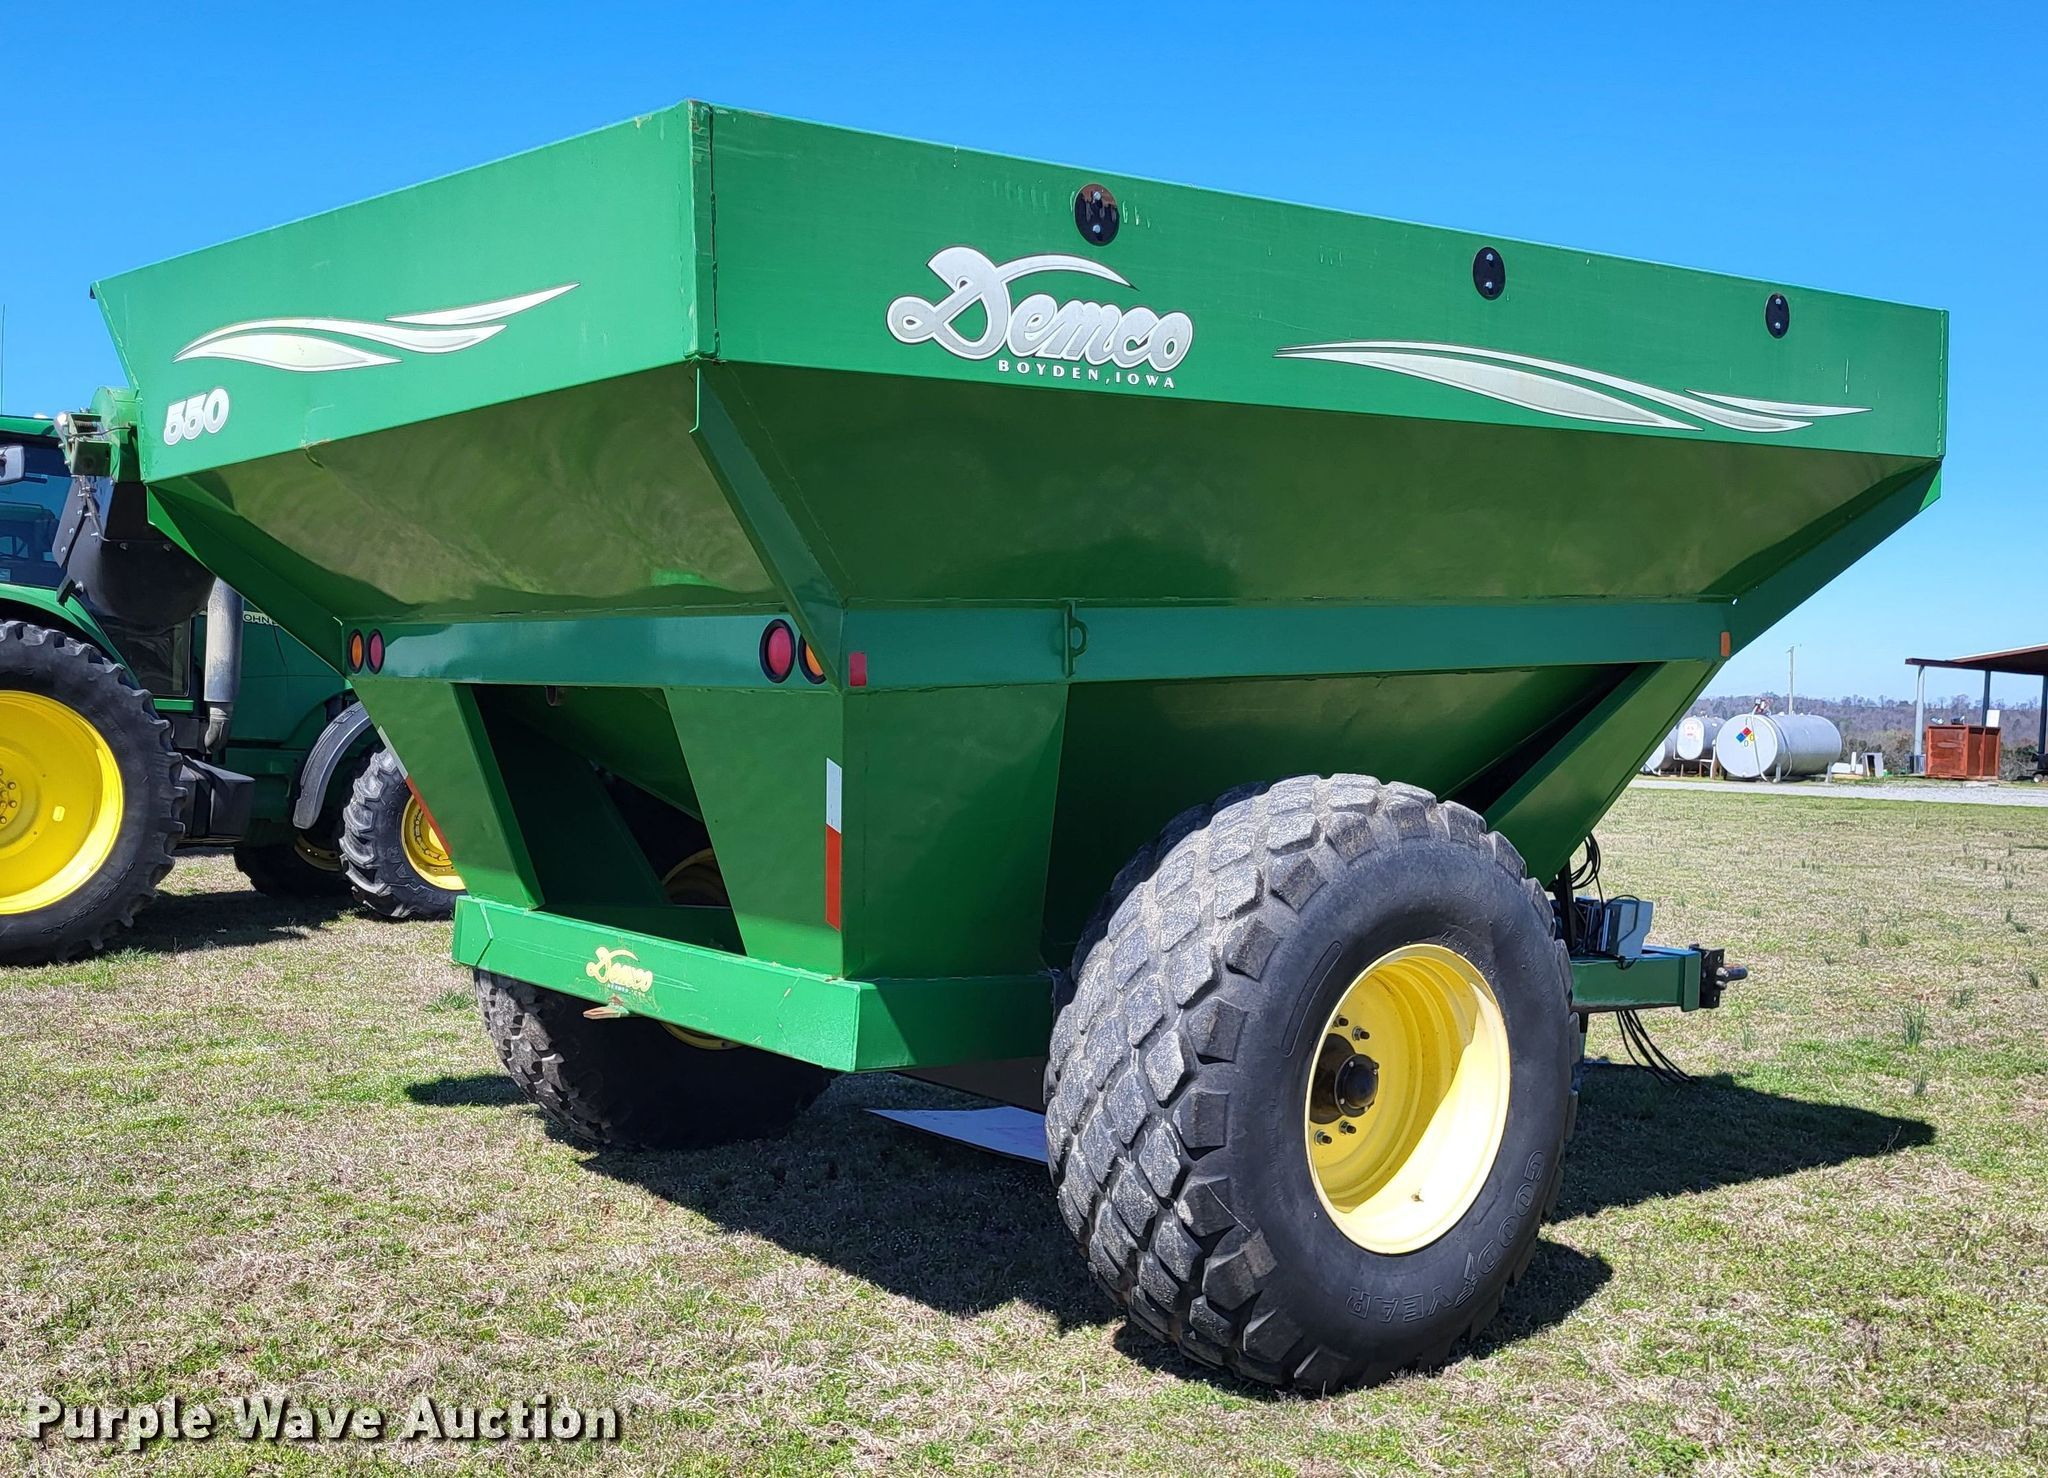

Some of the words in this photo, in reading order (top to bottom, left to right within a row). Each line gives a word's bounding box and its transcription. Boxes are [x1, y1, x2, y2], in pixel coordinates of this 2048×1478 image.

[886, 246, 1194, 373] Demco
[163, 387, 230, 445] 550
[243, 613, 271, 625] OHN
[585, 945, 654, 993] Demco
[1346, 1150, 1545, 1324] GOODYEAR
